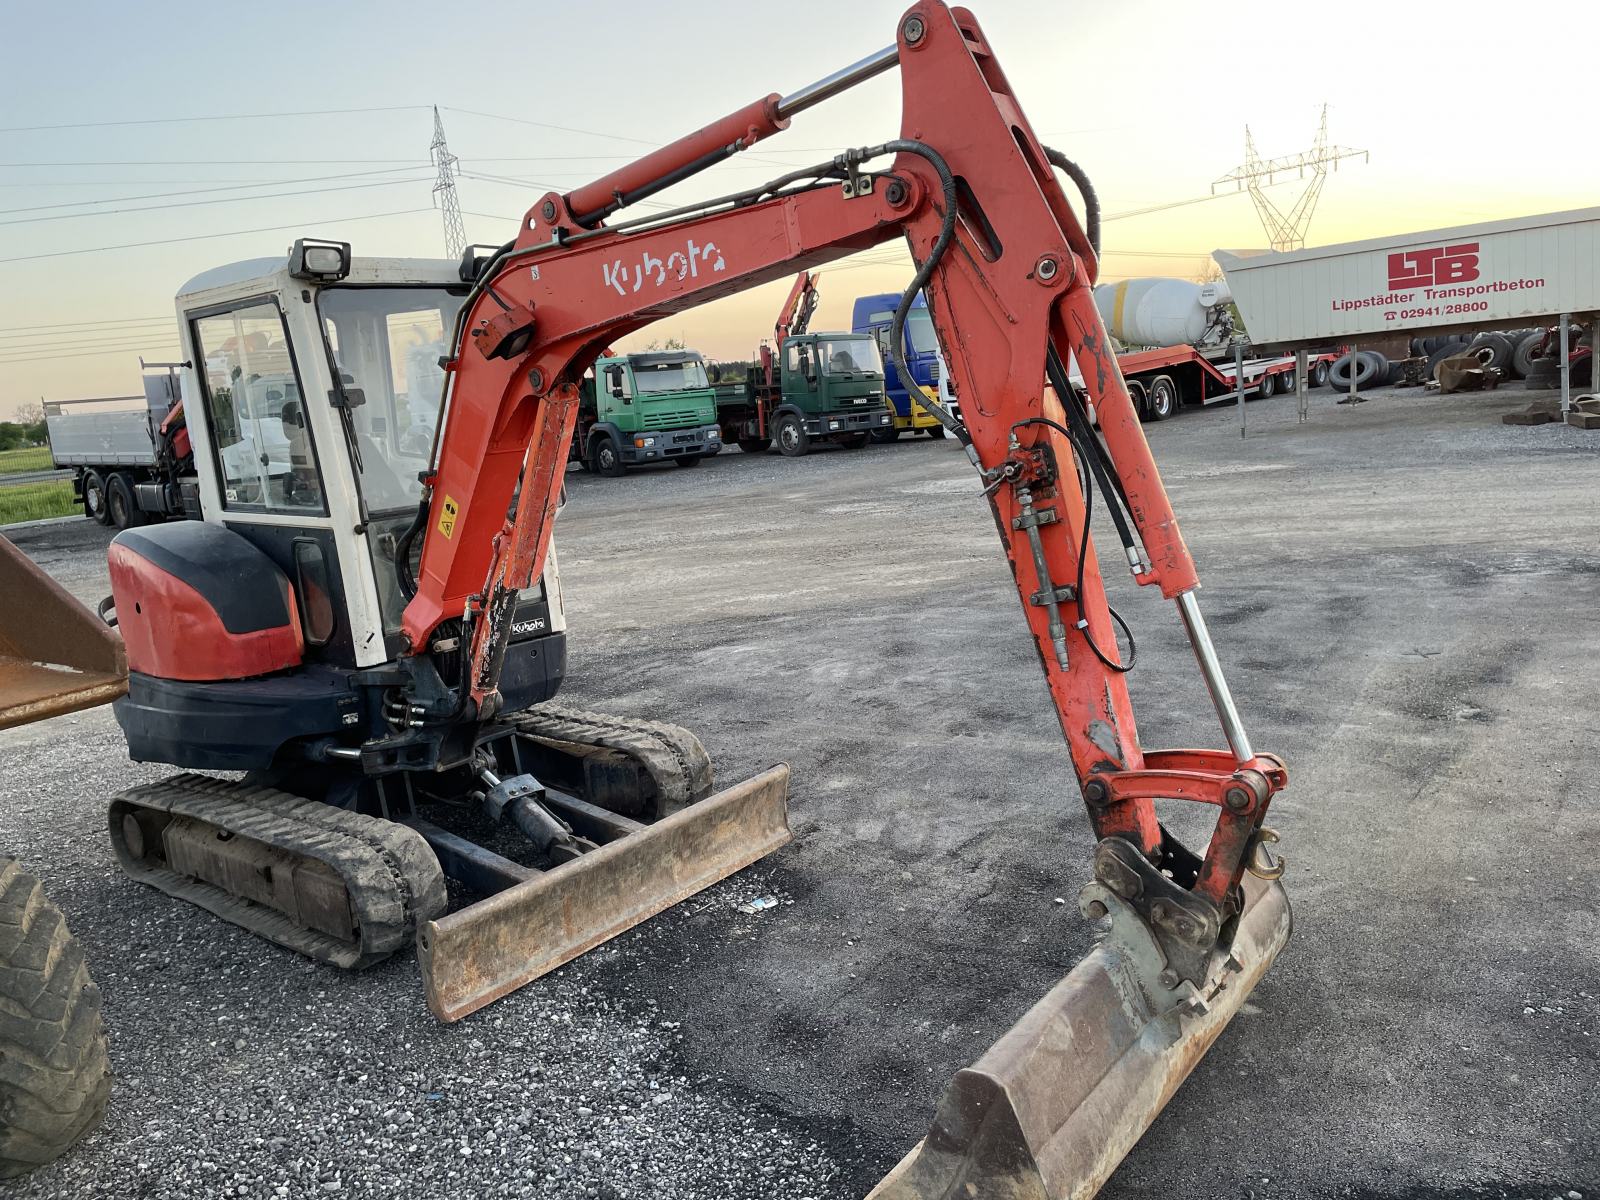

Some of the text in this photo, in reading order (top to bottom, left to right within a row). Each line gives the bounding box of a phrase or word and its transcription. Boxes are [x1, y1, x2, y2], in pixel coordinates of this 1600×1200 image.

[602, 239, 726, 296] Kubota
[1387, 242, 1480, 291] LTB
[1332, 278, 1545, 312] Lippstädter Transportbeton
[1400, 301, 1488, 319] 02941/28800
[512, 620, 545, 633] Kubota
